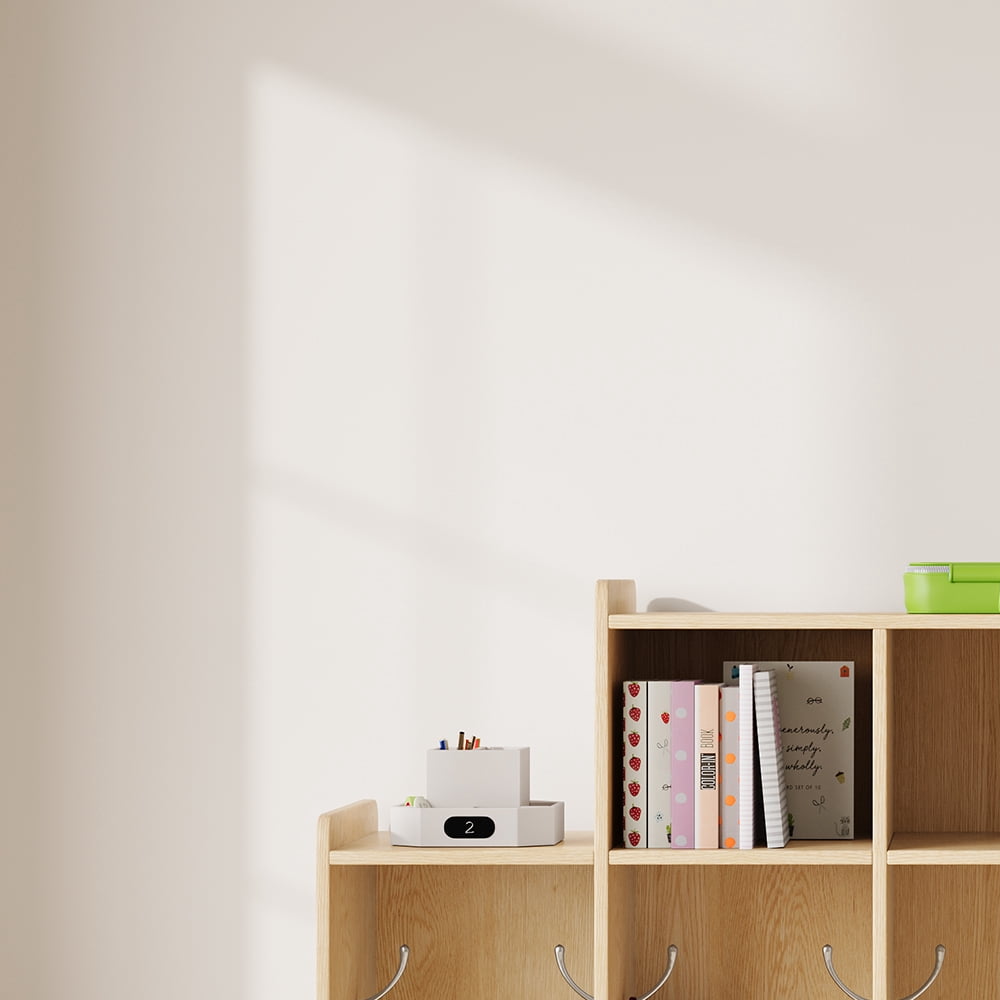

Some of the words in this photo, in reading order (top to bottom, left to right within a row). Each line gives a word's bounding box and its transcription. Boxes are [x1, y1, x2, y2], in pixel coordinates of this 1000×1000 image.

[700, 729, 714, 748] BOOK
[780, 723, 834, 740] enerously.
[785, 760, 822, 776] wholly.
[464, 821, 475, 834] 2
